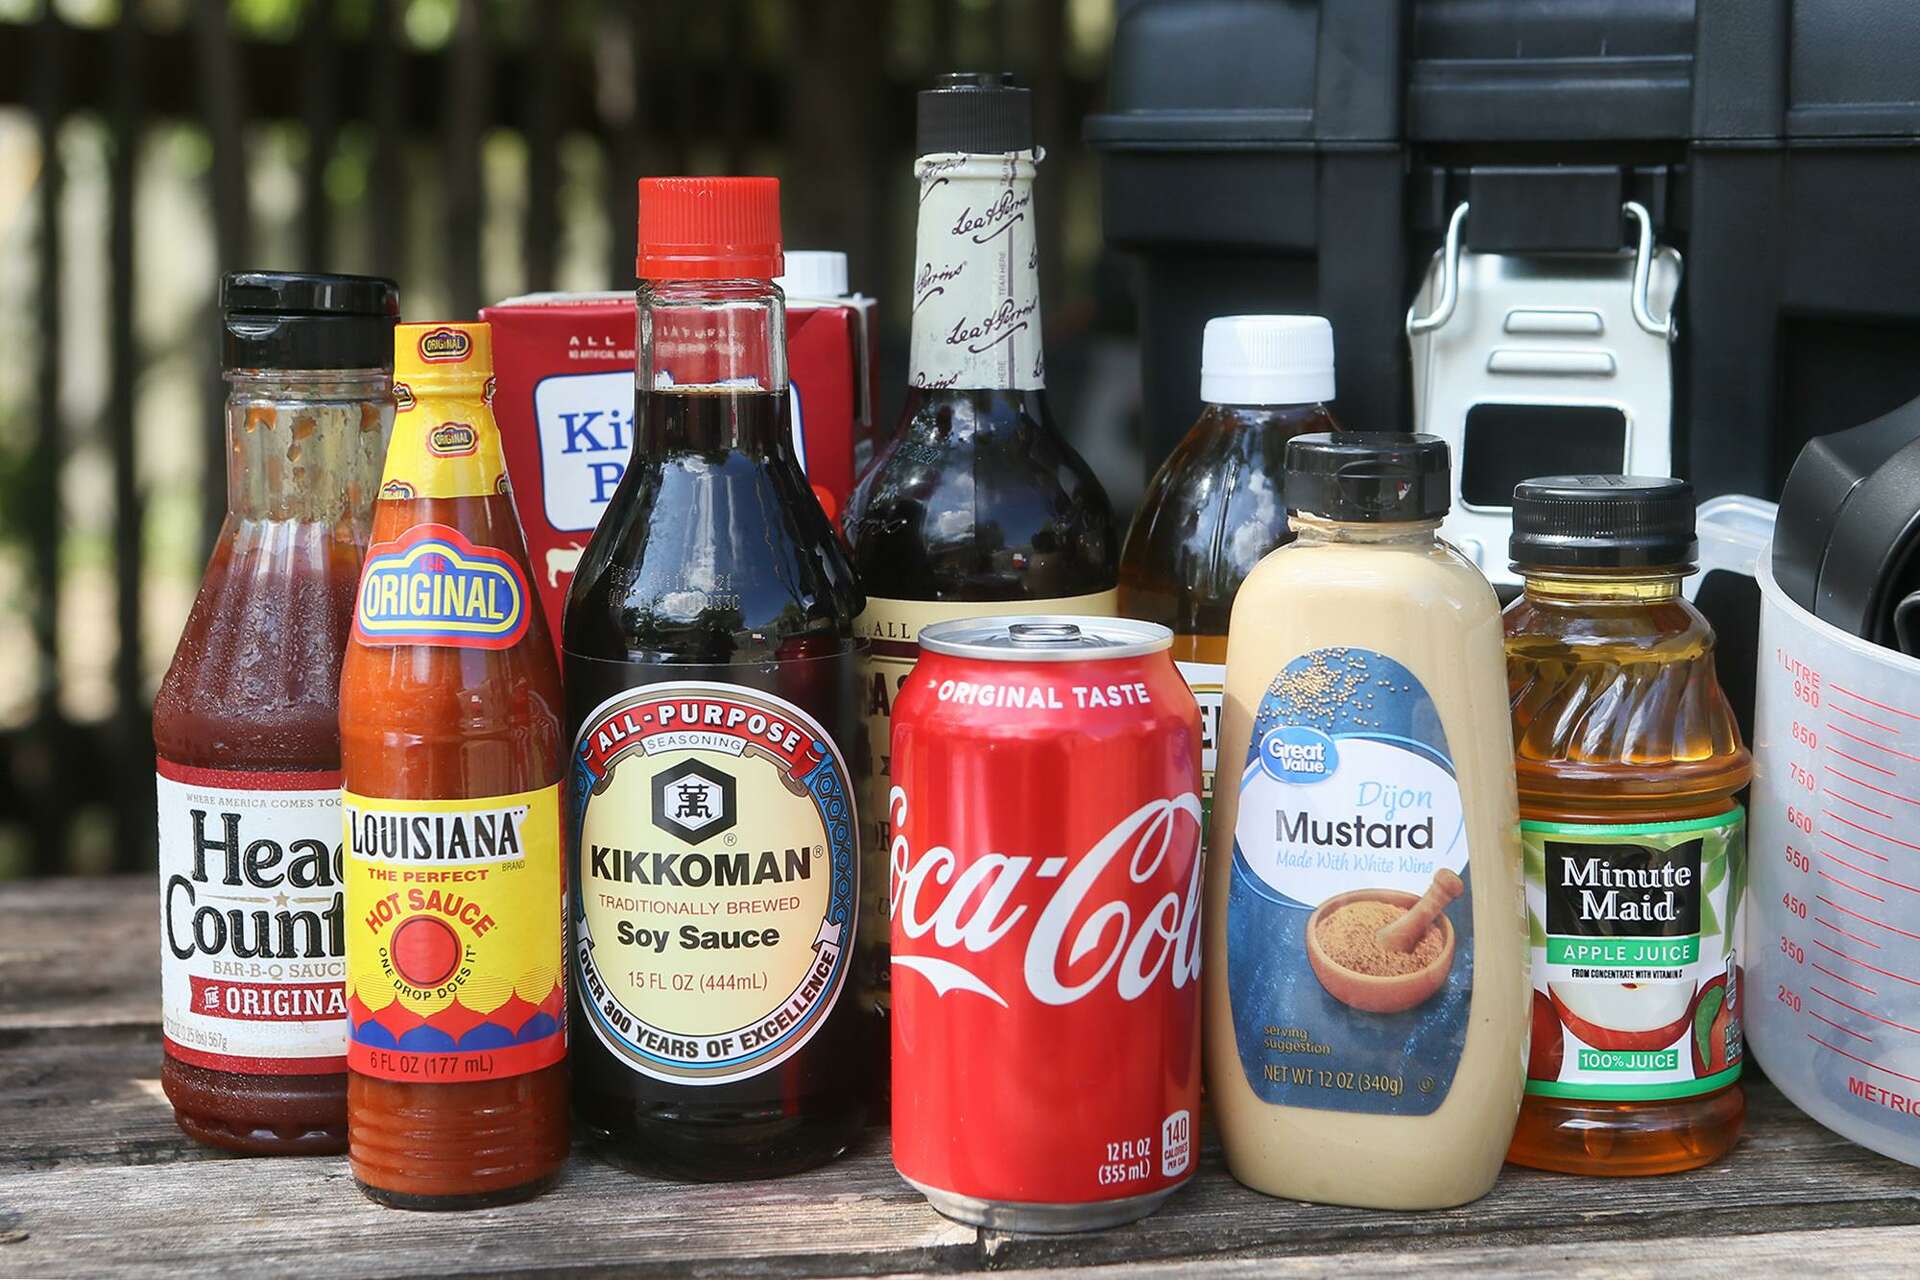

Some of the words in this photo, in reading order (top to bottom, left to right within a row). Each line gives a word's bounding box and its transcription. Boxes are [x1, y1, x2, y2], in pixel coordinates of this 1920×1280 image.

[427, 337, 462, 351] ORIGINAL
[569, 335, 616, 346] ALL
[946, 317, 983, 345] Lea
[434, 433, 469, 446] ORIGINAL
[366, 573, 505, 620] ORIGINAL
[1777, 648, 1782, 664] 1
[1784, 653, 1820, 689] LITRE
[937, 680, 1063, 709] ORIGINAL
[1072, 683, 1151, 708] TASTE
[1793, 680, 1820, 709] 950
[597, 703, 801, 753] ALL-PURPOSE
[1792, 720, 1817, 749] 850
[647, 734, 742, 750] SEASONING
[1268, 737, 1325, 761] Great
[1281, 757, 1325, 774] Value
[1790, 761, 1815, 791] 750
[218, 797, 268, 808] AMERICA
[271, 799, 314, 808] COMES
[1355, 781, 1433, 821] Dijon
[1275, 809, 1434, 850] Mustard
[1787, 806, 1812, 834] 650
[190, 809, 344, 889] Hea
[1276, 849, 1312, 869] Made
[1316, 852, 1350, 872] With
[1350, 854, 1394, 873] White
[1398, 858, 1434, 875] Wine
[1785, 846, 1809, 873] 550
[368, 868, 397, 881] THE
[403, 869, 489, 883] PERFECT
[502, 860, 526, 872] BRAND
[591, 844, 811, 888] KIKKOMAN
[1561, 856, 1692, 888] Minute
[365, 892, 402, 935] HOT
[408, 888, 496, 938] SAUCE
[598, 894, 719, 916] TRADITIONALLY
[727, 896, 801, 915] BREWED
[1579, 889, 1677, 921] Maid
[1782, 892, 1807, 919] 450
[617, 920, 669, 953] Soy
[679, 925, 781, 950] Sauce
[1780, 936, 1804, 964] 350
[1563, 944, 1626, 960] APPLE
[1633, 944, 1690, 961] JUICE
[213, 960, 284, 981] BAR-B-Q
[289, 961, 346, 978] SAUC
[379, 947, 395, 978] ONE
[393, 979, 432, 1001] DROP
[437, 967, 471, 999] DOES
[465, 949, 477, 963] IT
[628, 971, 645, 990] 15
[650, 972, 667, 990] FL
[672, 974, 694, 991] OZ
[699, 971, 768, 994] (444mL)
[1572, 968, 1590, 979] FROM
[1591, 969, 1634, 979] CONCENTRATE
[1635, 970, 1651, 979] WITH
[1652, 969, 1677, 979] VITAMIN
[205, 989, 220, 1006] THE
[226, 987, 347, 1016] ORIGINA
[580, 948, 606, 1003] OVER
[603, 999, 632, 1034] 300
[635, 1024, 699, 1059] YEARS
[706, 1037, 735, 1059] OF
[739, 949, 836, 1051] EXCELLENCE
[1777, 985, 1802, 1013] 250
[208, 1032, 228, 1051] 567g
[1264, 1024, 1309, 1041] serving
[1264, 1038, 1332, 1056] suggestion
[370, 1051, 377, 1068] 6
[381, 1053, 396, 1072] FL
[400, 1055, 419, 1074] OZ
[424, 1056, 459, 1077] (177
[464, 1054, 494, 1075] mL)
[1581, 1053, 1625, 1069] 100%
[1625, 1053, 1676, 1068] JUICE
[1264, 1064, 1289, 1082] NET
[1291, 1067, 1313, 1085] WT
[1319, 1071, 1333, 1088] 12
[1336, 1072, 1355, 1089] OZ
[1358, 1073, 1404, 1097] (340g)
[1167, 1117, 1187, 1146] 140
[1106, 1142, 1120, 1162] 12
[1122, 1140, 1134, 1160] FL
[1136, 1137, 1151, 1157] OZ
[1098, 1163, 1126, 1185] (355
[1128, 1158, 1151, 1180] mL)
